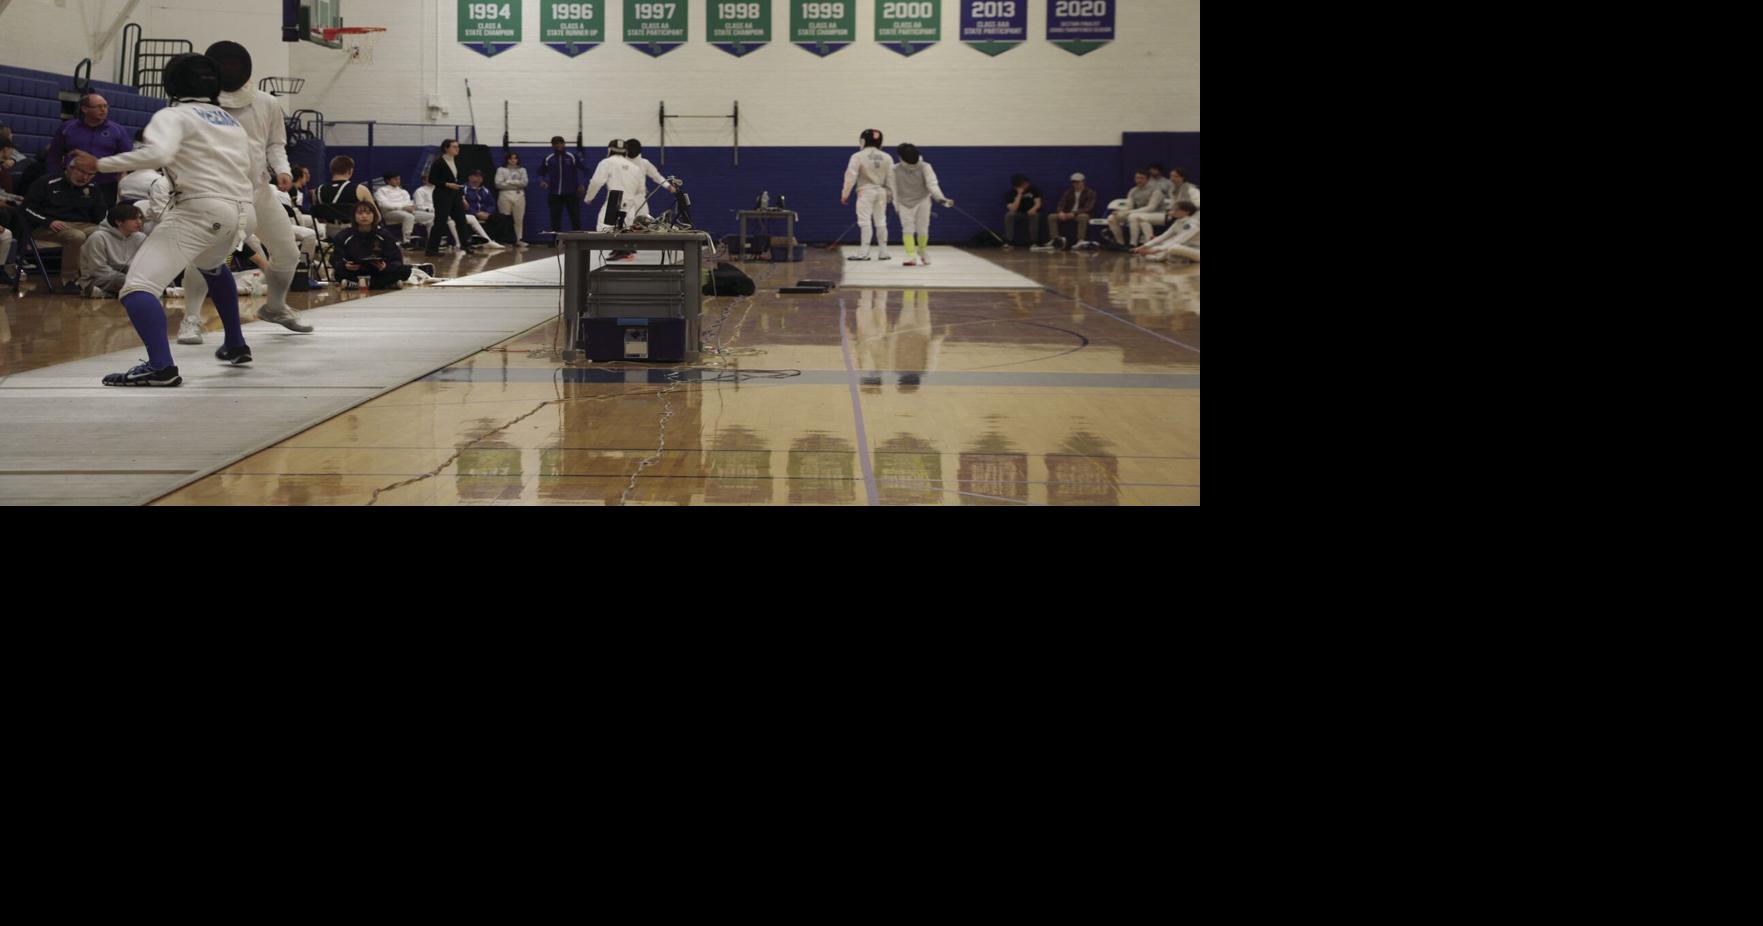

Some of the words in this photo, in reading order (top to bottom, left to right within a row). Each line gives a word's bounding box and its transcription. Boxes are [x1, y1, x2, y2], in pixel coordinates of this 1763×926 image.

[468, 4, 510, 20] 1994
[552, 4, 593, 20] 1996
[635, 4, 676, 19] 1997
[718, 3, 760, 19] 1998
[802, 3, 844, 19] 1999
[883, 2, 932, 18] 2000
[972, 1, 1015, 18] 2013
[1056, 1, 1106, 17] 2020
